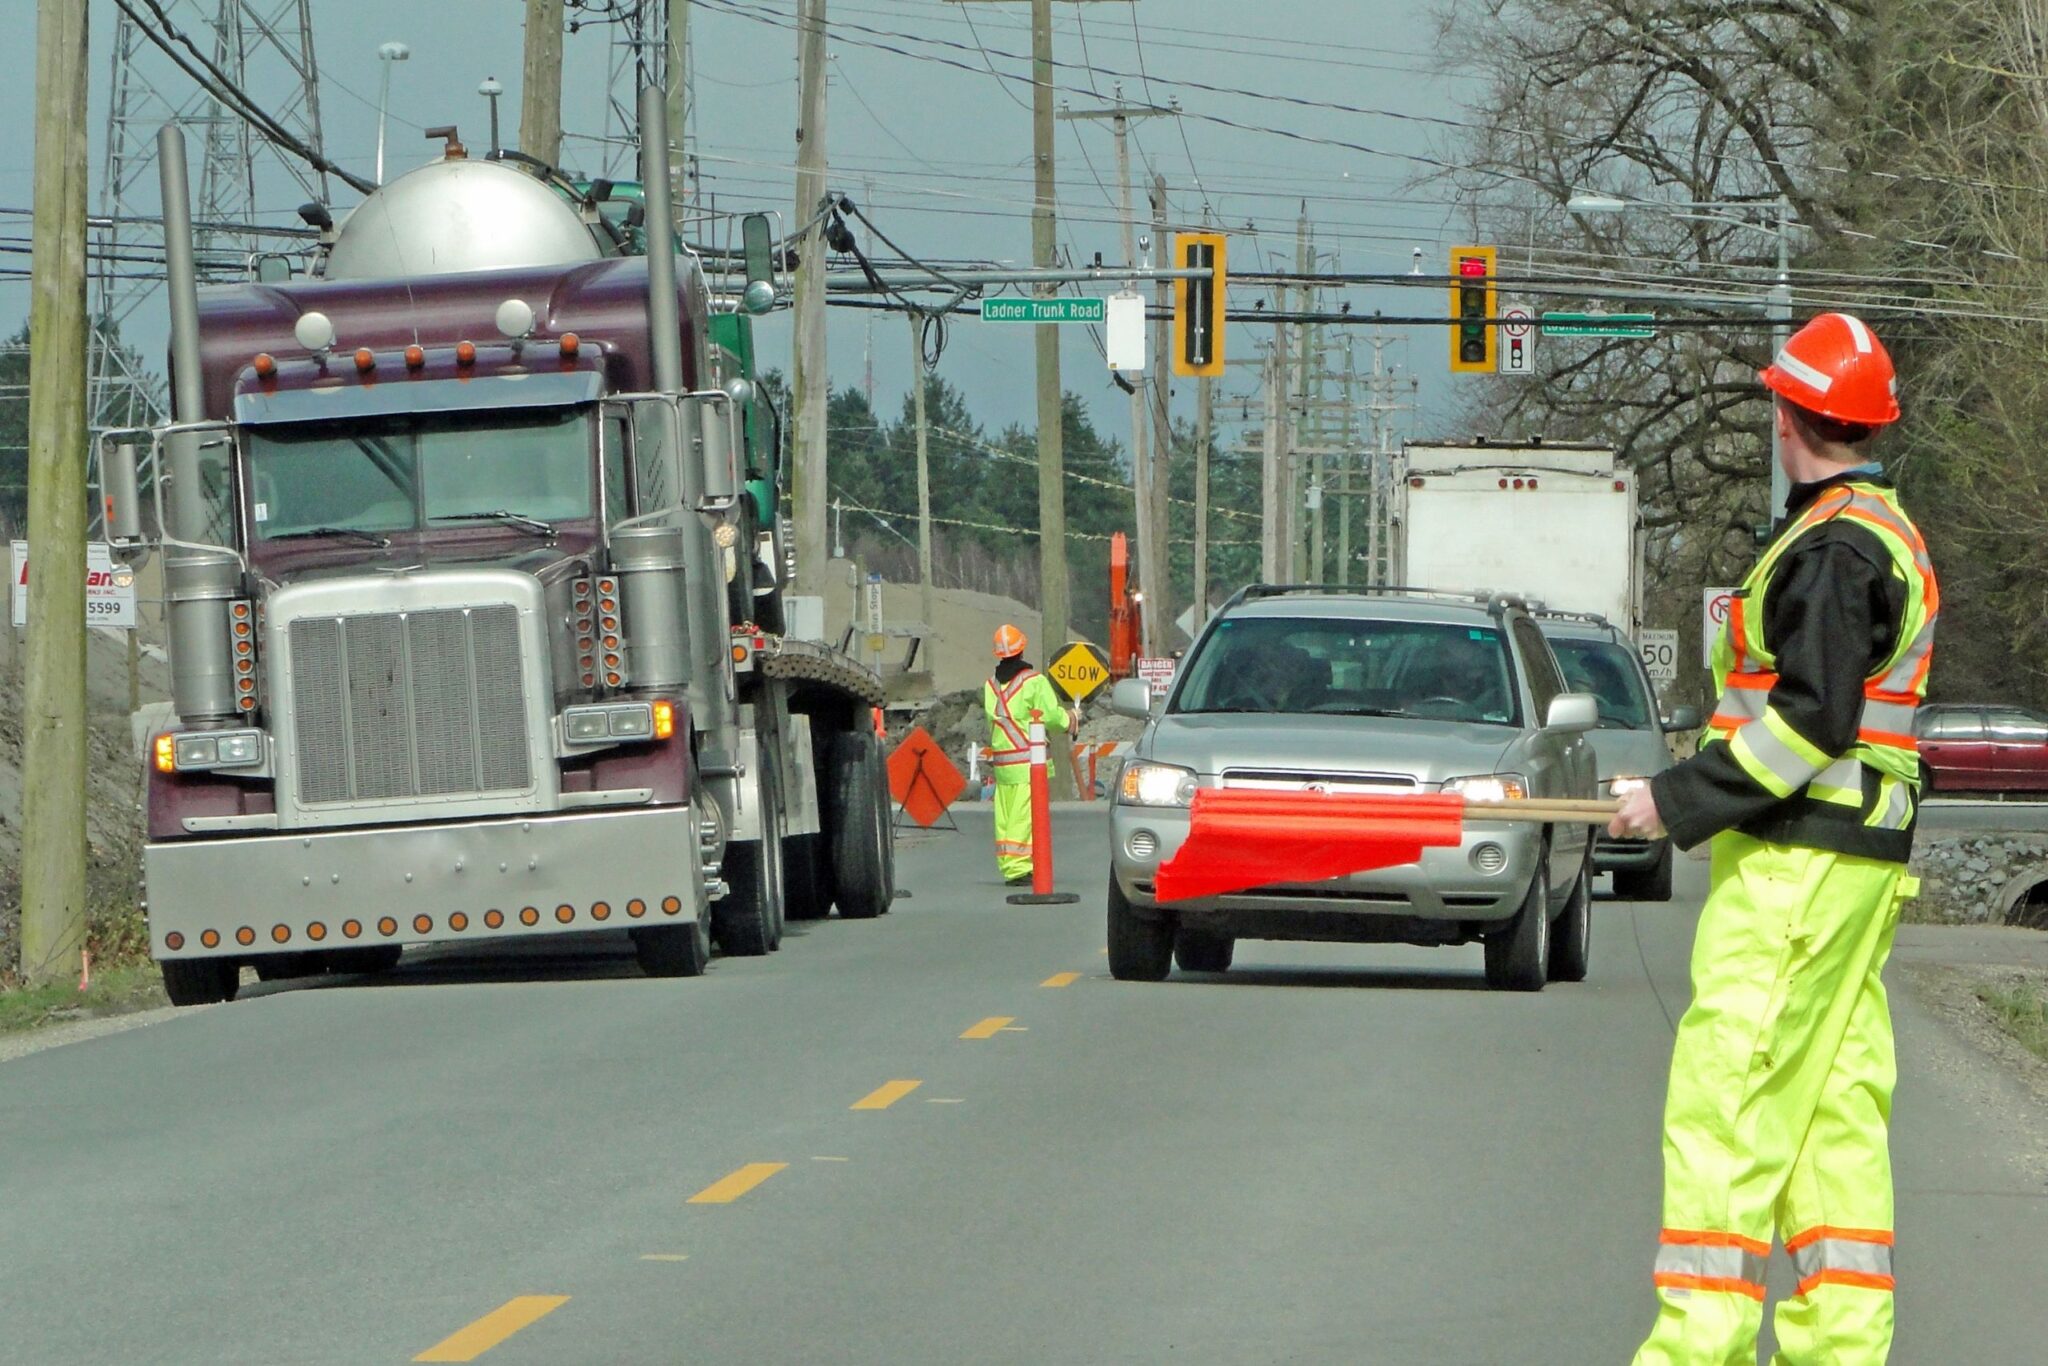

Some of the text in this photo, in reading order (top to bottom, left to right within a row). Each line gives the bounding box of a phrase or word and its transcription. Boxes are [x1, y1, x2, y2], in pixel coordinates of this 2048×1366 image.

[985, 303, 1101, 318] Ladner Trunk Road
[1643, 644, 1673, 666] 50
[1057, 664, 1101, 682] SLOW
[1648, 667, 1672, 677] m/h
